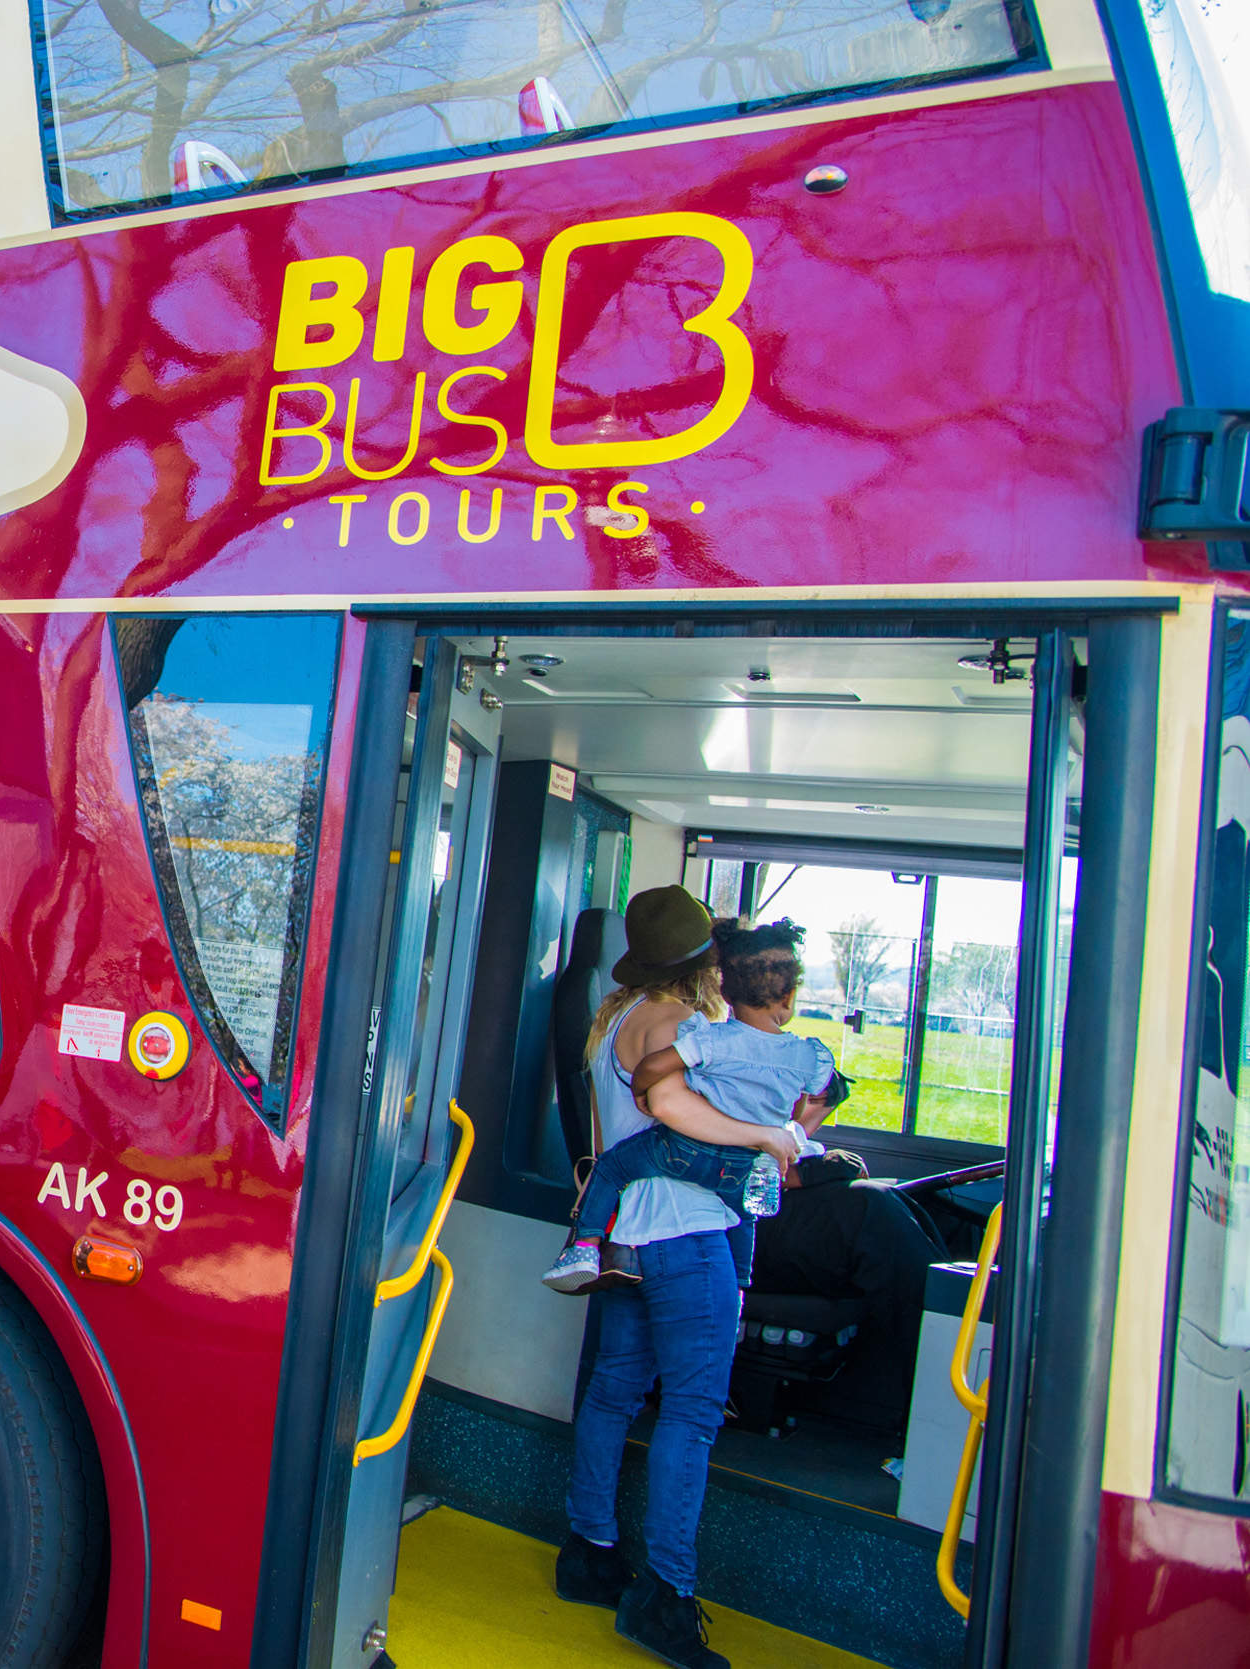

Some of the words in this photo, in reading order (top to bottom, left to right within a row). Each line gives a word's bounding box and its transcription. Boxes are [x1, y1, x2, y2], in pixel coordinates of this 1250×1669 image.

[273, 235, 525, 372] BIG
[259, 365, 509, 486] BUS
[329, 481, 650, 547] TOURS
[37, 1162, 109, 1217] AK
[123, 1179, 183, 1231] 89
